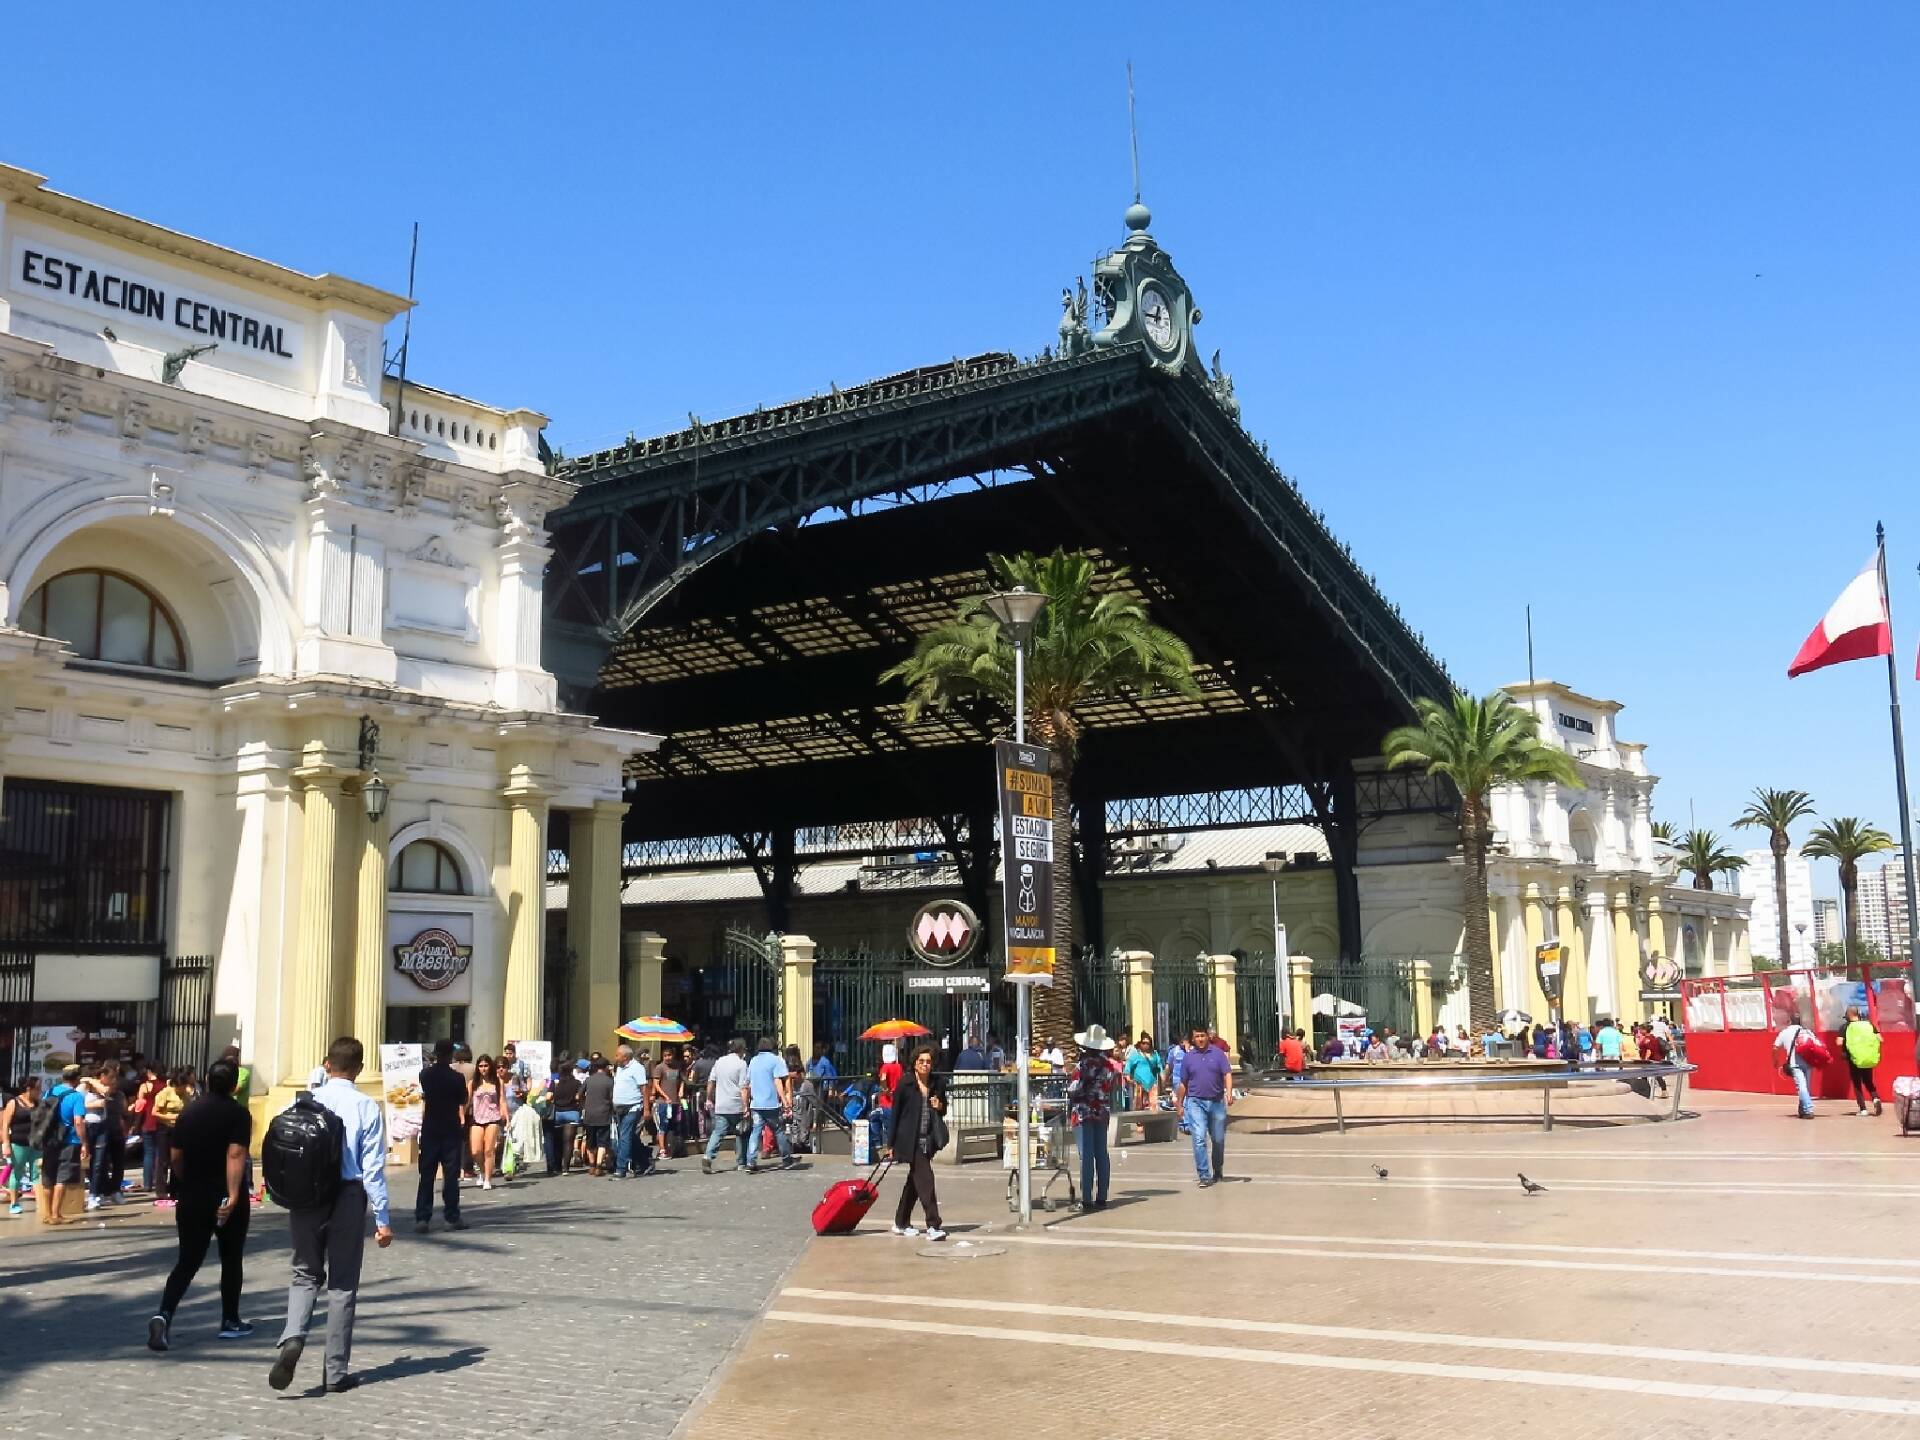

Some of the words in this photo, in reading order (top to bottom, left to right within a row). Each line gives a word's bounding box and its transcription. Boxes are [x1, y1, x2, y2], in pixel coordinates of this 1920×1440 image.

[22, 249, 165, 321] ESTACION
[174, 296, 294, 359] CENTRAL
[423, 944, 448, 956] Juan
[399, 951, 467, 970] Maestro
[908, 977, 944, 987] ESTACION
[946, 976, 981, 987] CENTRAL
